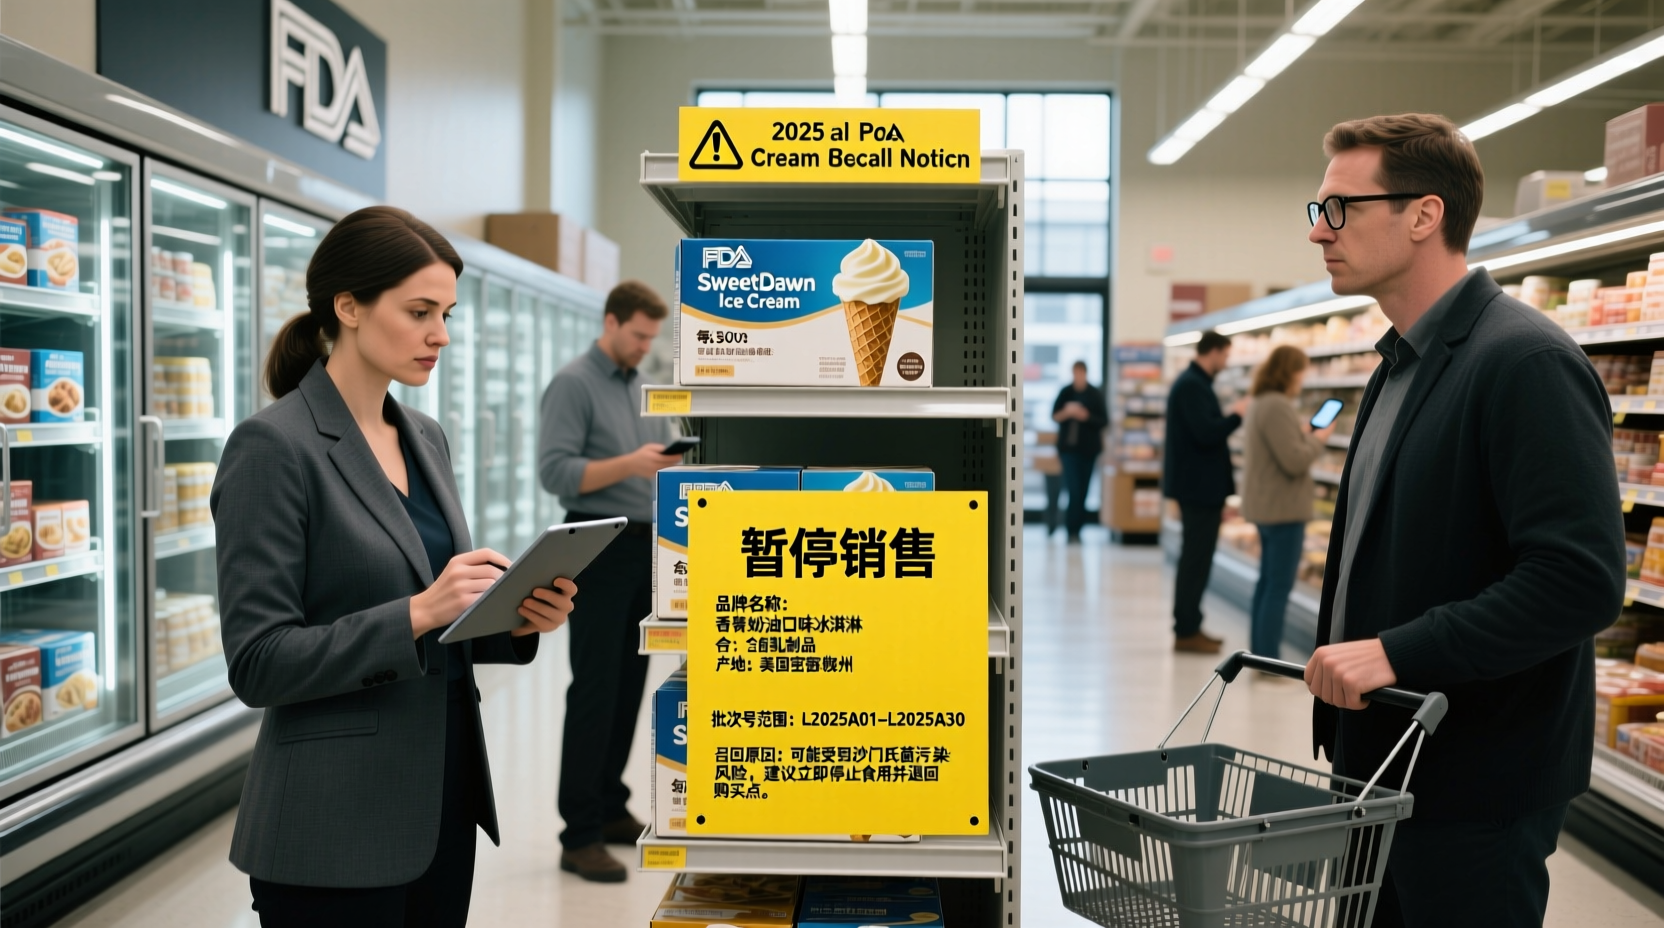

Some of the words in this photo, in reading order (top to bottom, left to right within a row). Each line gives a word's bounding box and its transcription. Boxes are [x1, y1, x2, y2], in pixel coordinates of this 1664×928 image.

[270, 0, 381, 160] FDA
[772, 122, 825, 142] 2025
[750, 147, 820, 168] Cream
[703, 245, 753, 269] FDA
[697, 272, 816, 292] SweetDawn
[719, 293, 744, 309] Ice
[747, 293, 800, 309] Cream
[740, 526, 936, 579] 暂停销售
[715, 594, 788, 613] 品牌名称：
[713, 782, 769, 800] 购买点。
